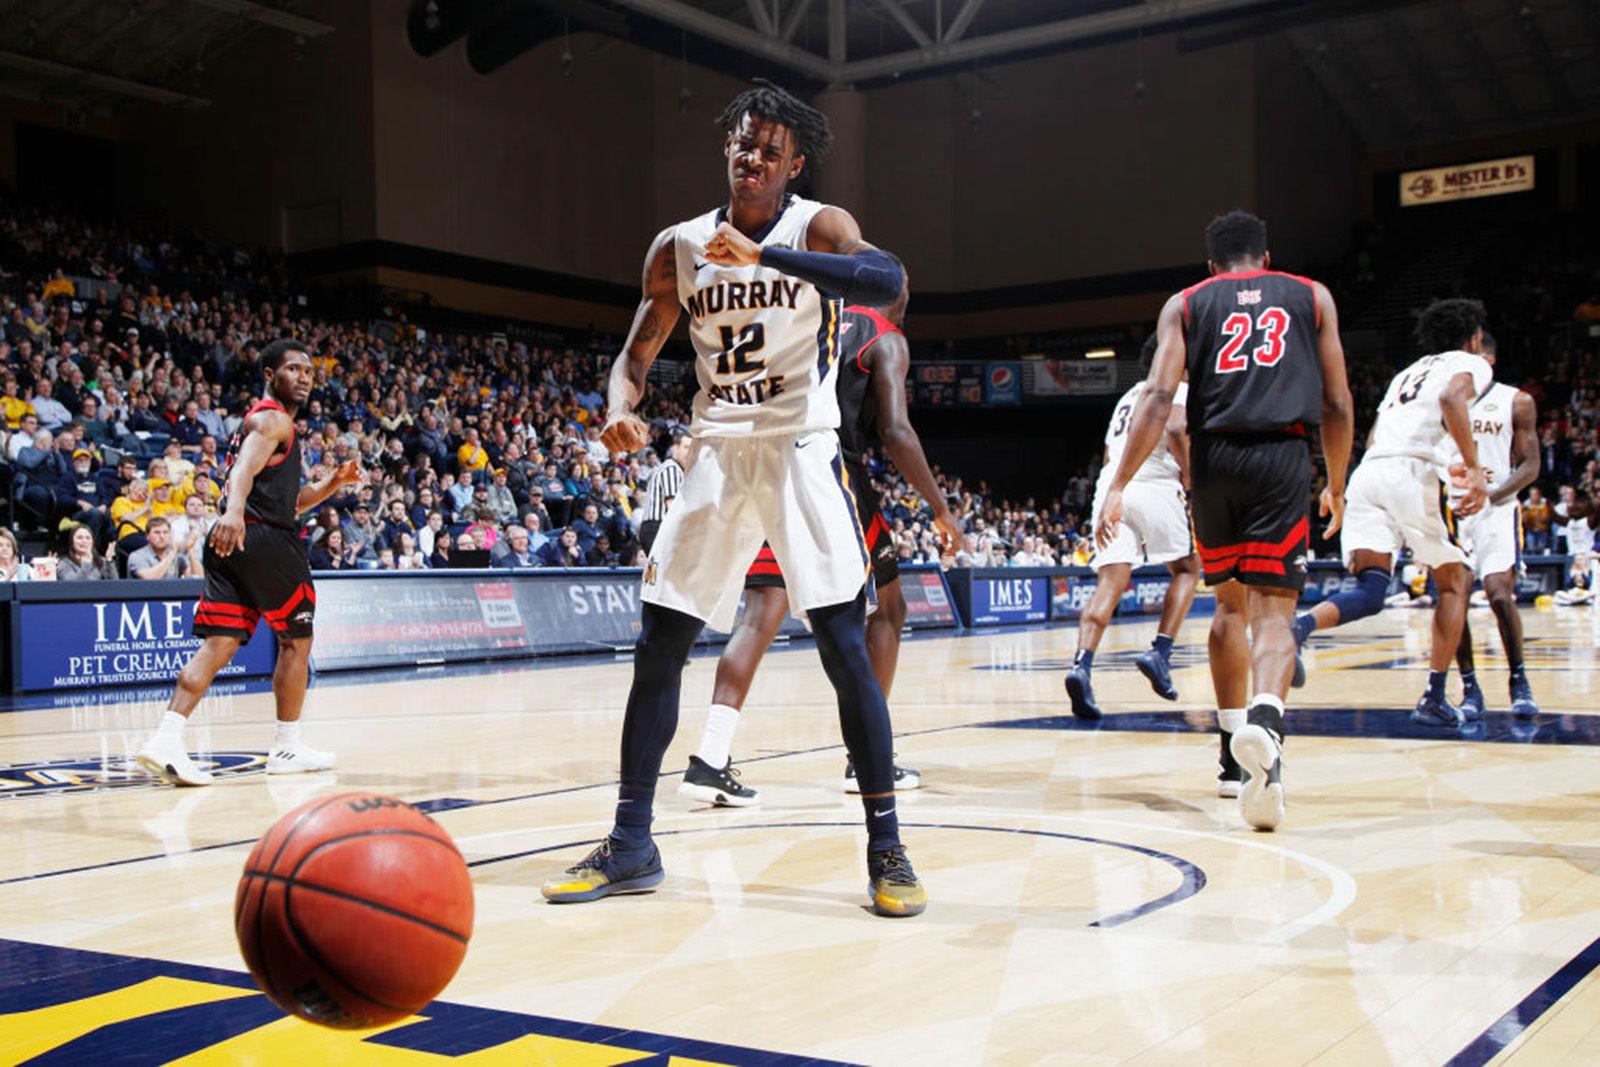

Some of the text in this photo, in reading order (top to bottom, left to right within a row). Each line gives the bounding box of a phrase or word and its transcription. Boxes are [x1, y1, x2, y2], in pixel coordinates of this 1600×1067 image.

[1444, 166, 1501, 187] MISTER
[1505, 163, 1526, 179] B's
[687, 279, 801, 321] MURRAY
[716, 322, 765, 375] 12
[1215, 306, 1290, 374] 23
[708, 375, 785, 405] STATE
[1114, 404, 1132, 437] 3
[1472, 419, 1503, 437] RAY
[569, 584, 636, 615] STAY
[989, 579, 1032, 606] IMES
[1137, 582, 1169, 604] PEPS
[94, 643, 129, 653] FUNERAL
[132, 641, 155, 650] HOME
[165, 639, 202, 649] CREMATO
[68, 651, 195, 676] PET CREMAT
[97, 673, 135, 684] TRUSTED
[136, 670, 167, 681] SOURCE
